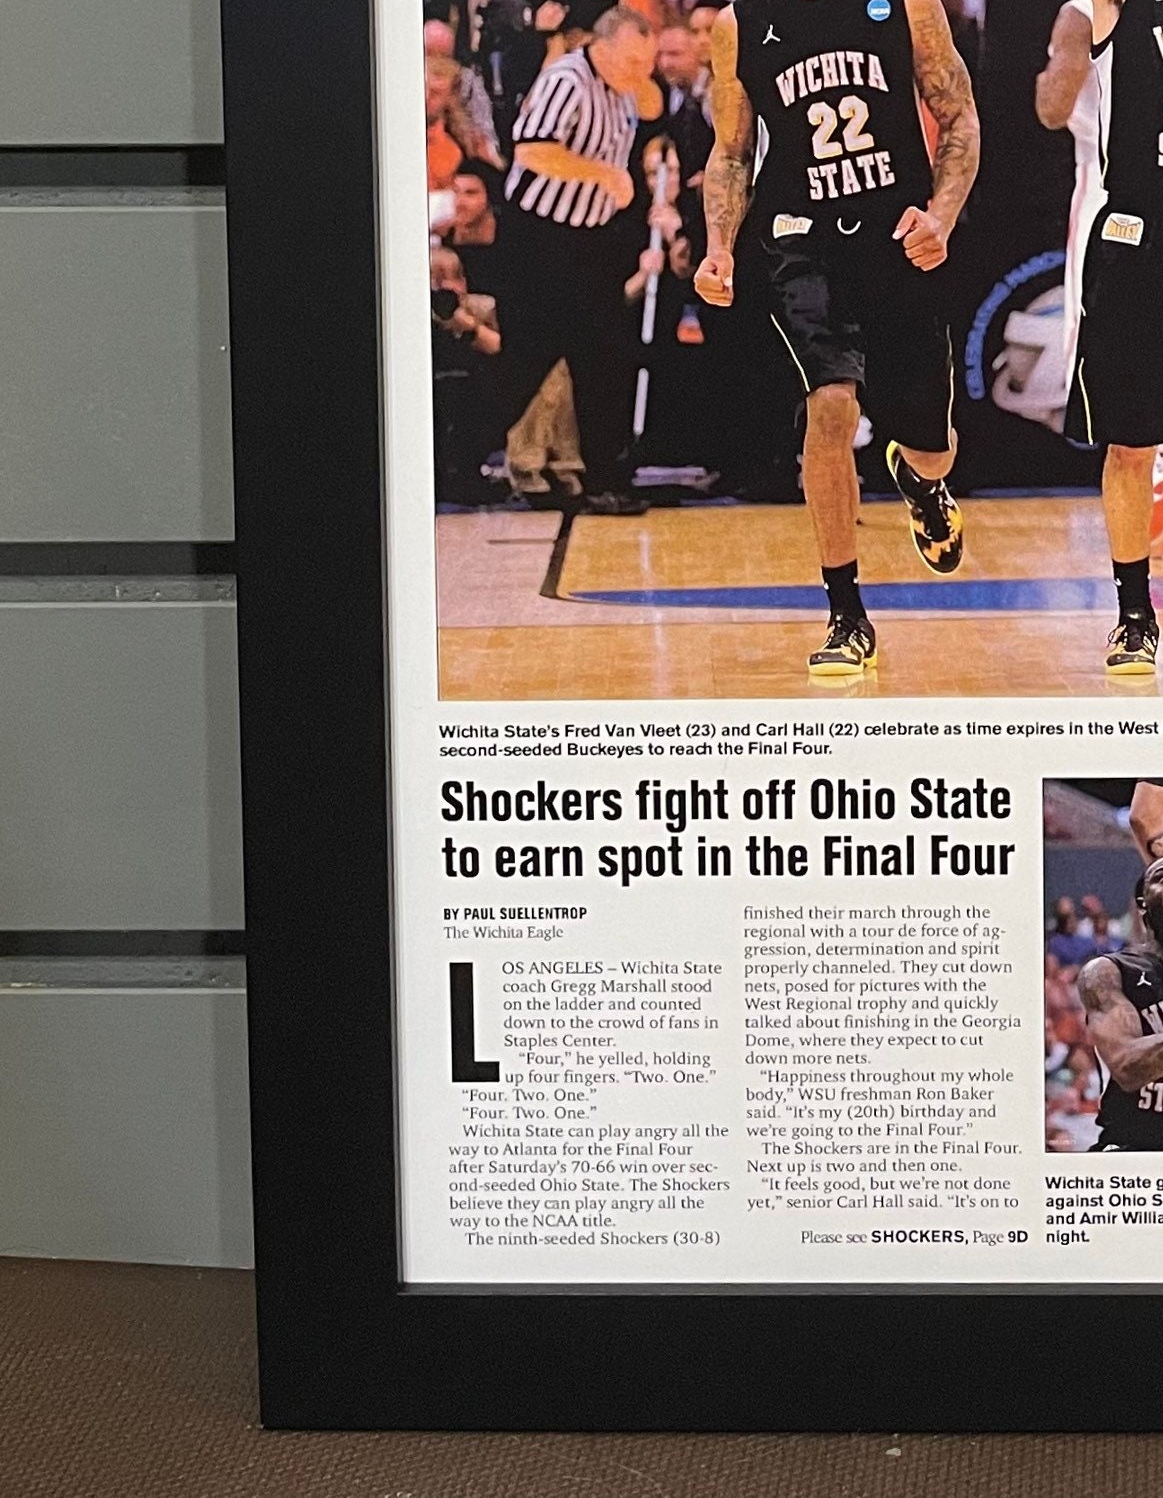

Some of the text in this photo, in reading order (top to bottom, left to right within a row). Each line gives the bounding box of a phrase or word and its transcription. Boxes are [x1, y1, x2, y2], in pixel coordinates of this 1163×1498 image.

[775, 50, 889, 107] WICHITA
[807, 95, 875, 159] 22
[807, 151, 896, 200] STATE
[438, 725, 499, 739] Wichita
[504, 724, 560, 738] State's
[564, 724, 600, 738] Fred
[604, 724, 635, 737] Van
[639, 724, 682, 738] Vleet
[685, 723, 716, 739] (23)
[721, 723, 751, 737] and
[756, 722, 788, 737] Carl
[793, 722, 824, 736] Hall
[829, 722, 859, 738] (22)
[864, 722, 939, 736] celebrate
[943, 724, 962, 735] as
[966, 721, 1002, 735] time
[1006, 721, 1065, 738] expires
[1069, 721, 1083, 735] in
[1088, 721, 1114, 735] the
[1118, 721, 1159, 735] West
[439, 741, 833, 759] second-seeded Buckeyes to reach the Final Four.
[441, 777, 1011, 833] Shockers fight off Ohio State
[441, 834, 1016, 887] to earn spot in the Final Four
[443, 906, 587, 921] BY PAUL SUELLENTROP
[443, 925, 564, 942] The Wichita Eagle
[744, 995, 999, 1014] West Regional trophy and quickly
[462, 1123, 729, 1142] Wichita State can play angry all the
[1044, 1176, 1104, 1189] Wichita
[1109, 1176, 1152, 1189] State
[801, 1229, 1029, 1247] Please see SHOCKERS, Page 9D
[1046, 1229, 1090, 1246] night.
